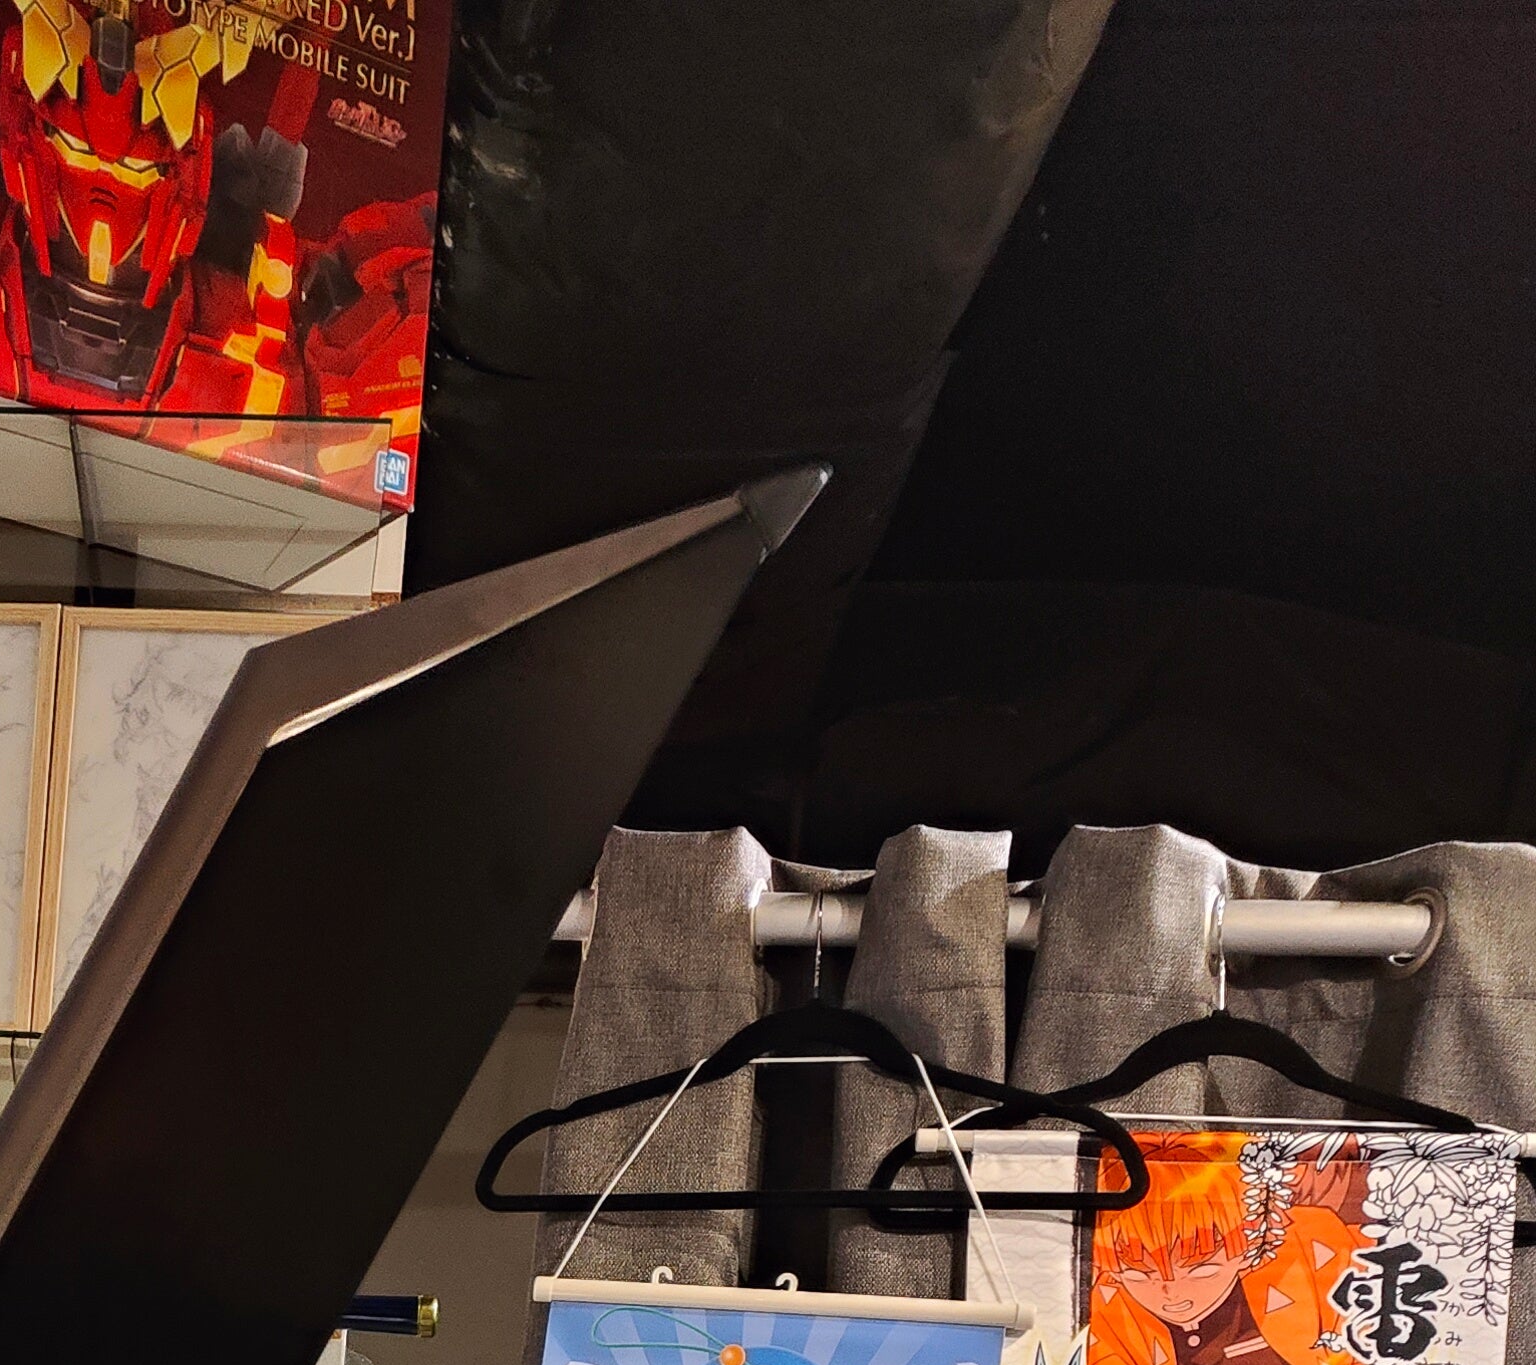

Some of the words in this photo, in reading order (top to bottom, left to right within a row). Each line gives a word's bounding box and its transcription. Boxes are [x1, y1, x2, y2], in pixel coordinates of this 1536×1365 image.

[254, 21, 349, 82] MOBILE
[355, 62, 410, 104] SUIT
[354, 4, 414, 61] Ver.]
[1331, 1242, 1449, 1361] 雷
